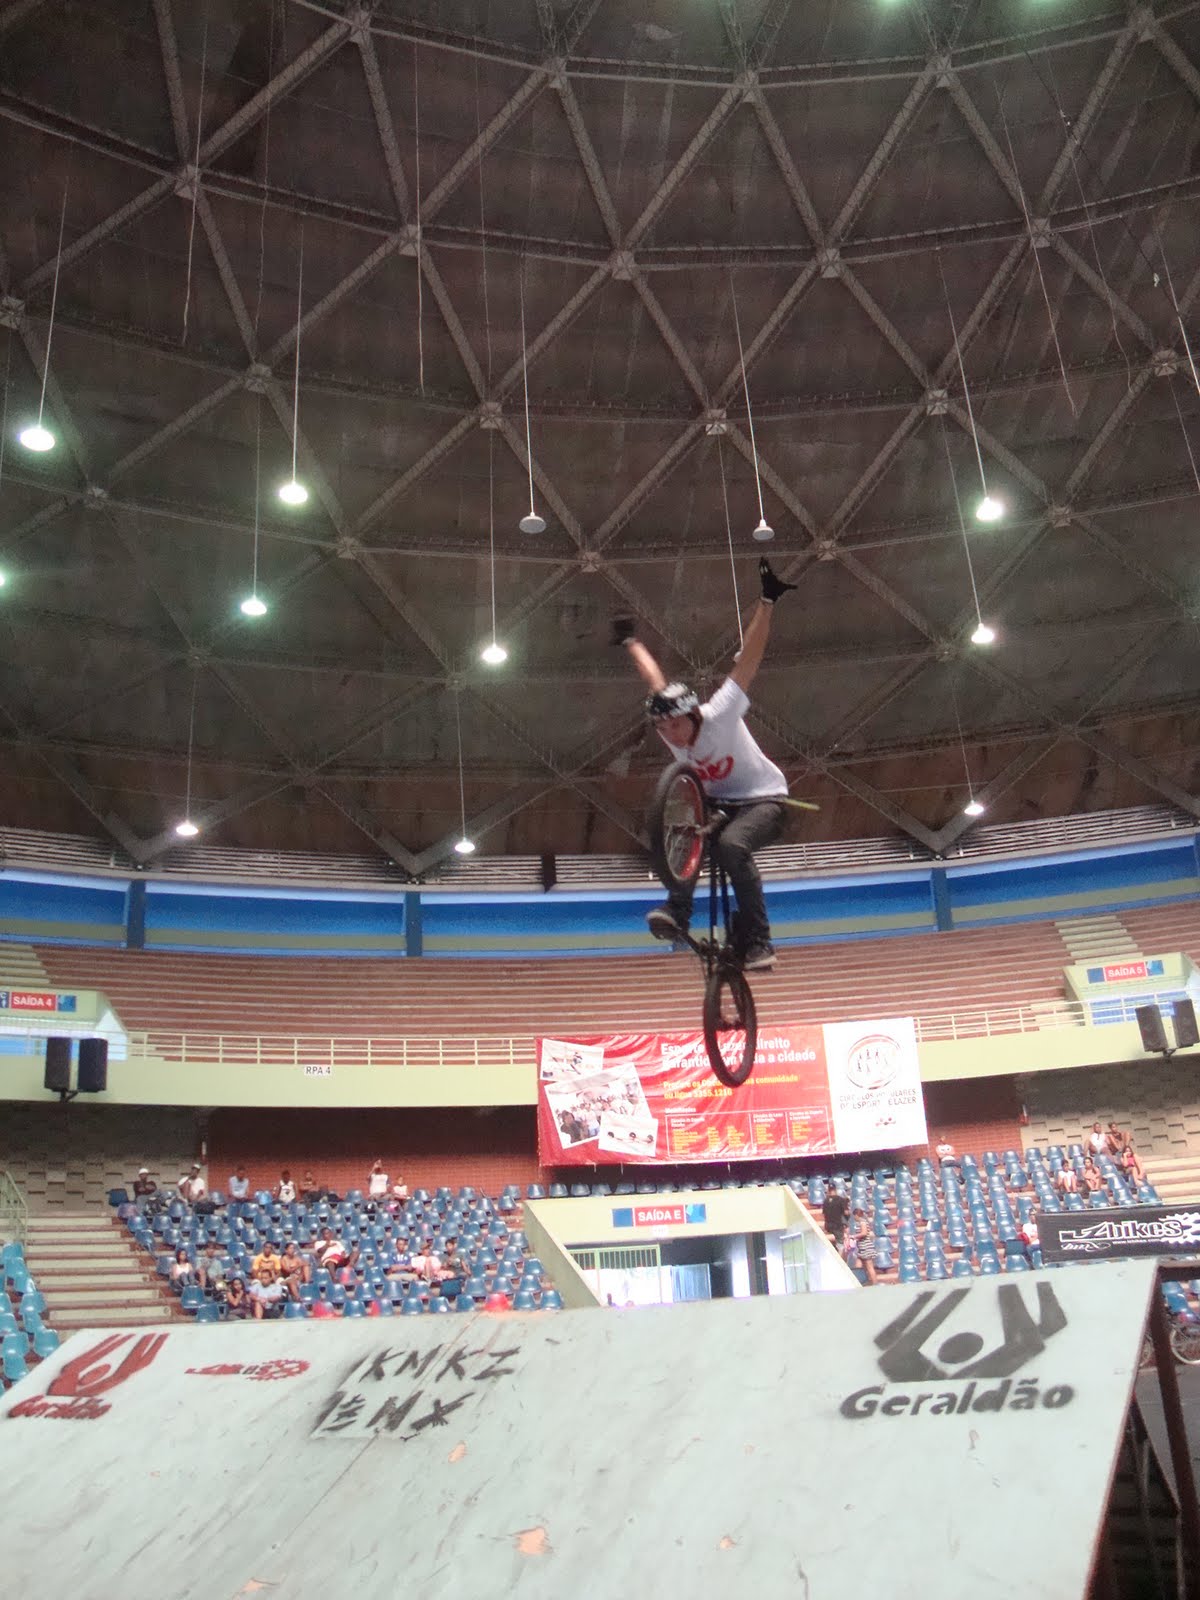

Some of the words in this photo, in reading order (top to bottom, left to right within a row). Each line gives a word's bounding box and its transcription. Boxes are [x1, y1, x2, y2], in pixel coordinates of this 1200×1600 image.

[1108, 967, 1136, 978] SAÍDA
[13, 995, 45, 1006] SAÍDA
[46, 998, 52, 1006] 4
[768, 1053, 775, 1063] a
[777, 1049, 816, 1063] cidade
[306, 1066, 323, 1074] RPA
[755, 1074, 798, 1084] comunidade
[638, 1209, 672, 1222] SAÍDA
[674, 1209, 682, 1220] E
[840, 1378, 1075, 1419] Geraldão
